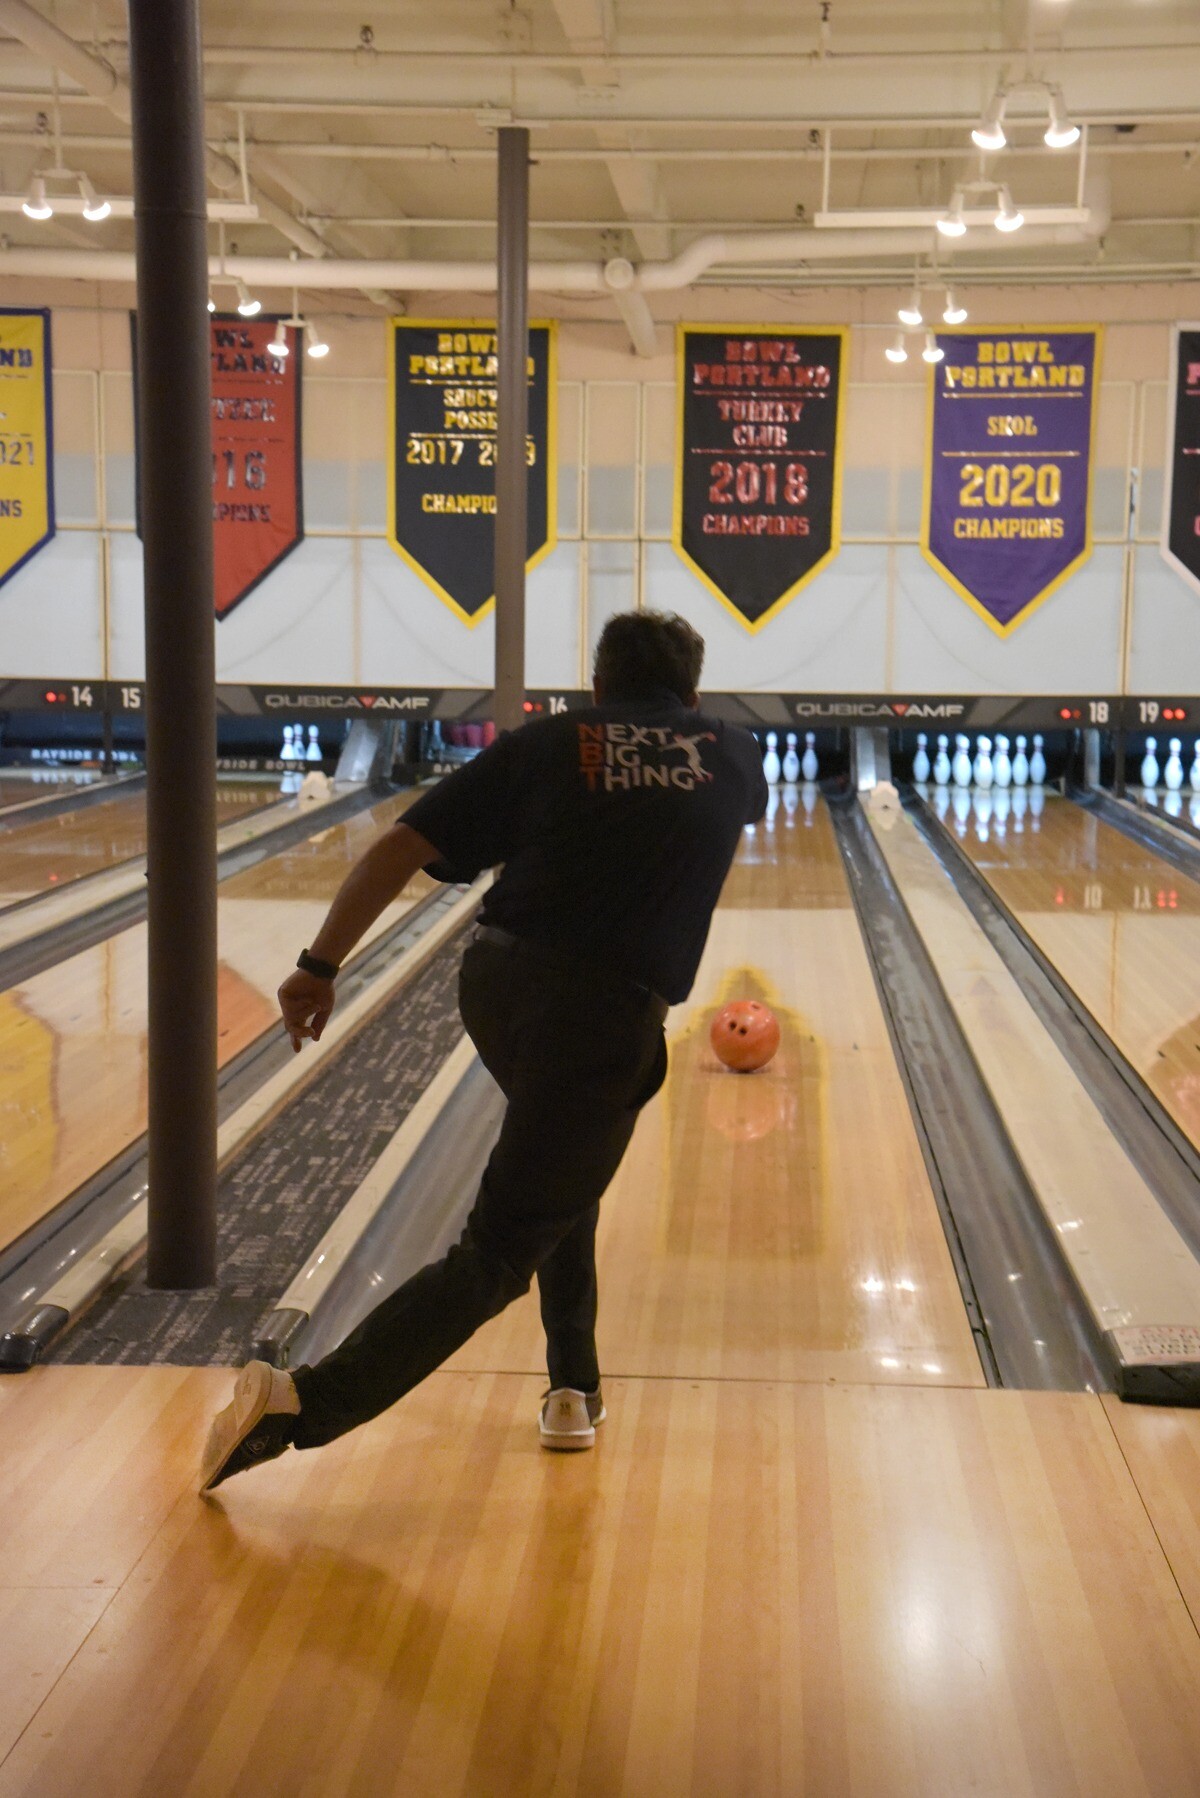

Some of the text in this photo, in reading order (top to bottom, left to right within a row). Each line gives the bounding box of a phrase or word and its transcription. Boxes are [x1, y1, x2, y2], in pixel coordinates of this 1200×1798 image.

[214, 329, 254, 348] WL
[725, 341, 801, 363] BOWL
[977, 341, 1054, 363] BOWL
[409, 355, 535, 376] PORTLAD
[693, 364, 831, 387] PORTLAND
[945, 365, 1085, 388] PORTLAND
[732, 425, 788, 447] CLUB
[987, 416, 1038, 436] SKOL
[406, 440, 464, 465] 2017
[709, 461, 808, 504] 2018
[959, 464, 1061, 507] 2020
[421, 494, 498, 514] CHAMPIO
[702, 514, 810, 536] CHAMPIONS
[953, 517, 1064, 539] CHAMPIONS
[71, 686, 93, 707] 14
[121, 687, 141, 708] 15
[1089, 701, 1109, 724] 18
[1139, 701, 1159, 724] 19
[577, 723, 672, 746] NEXT
[579, 742, 641, 767] BIG
[579, 765, 695, 791] THING
